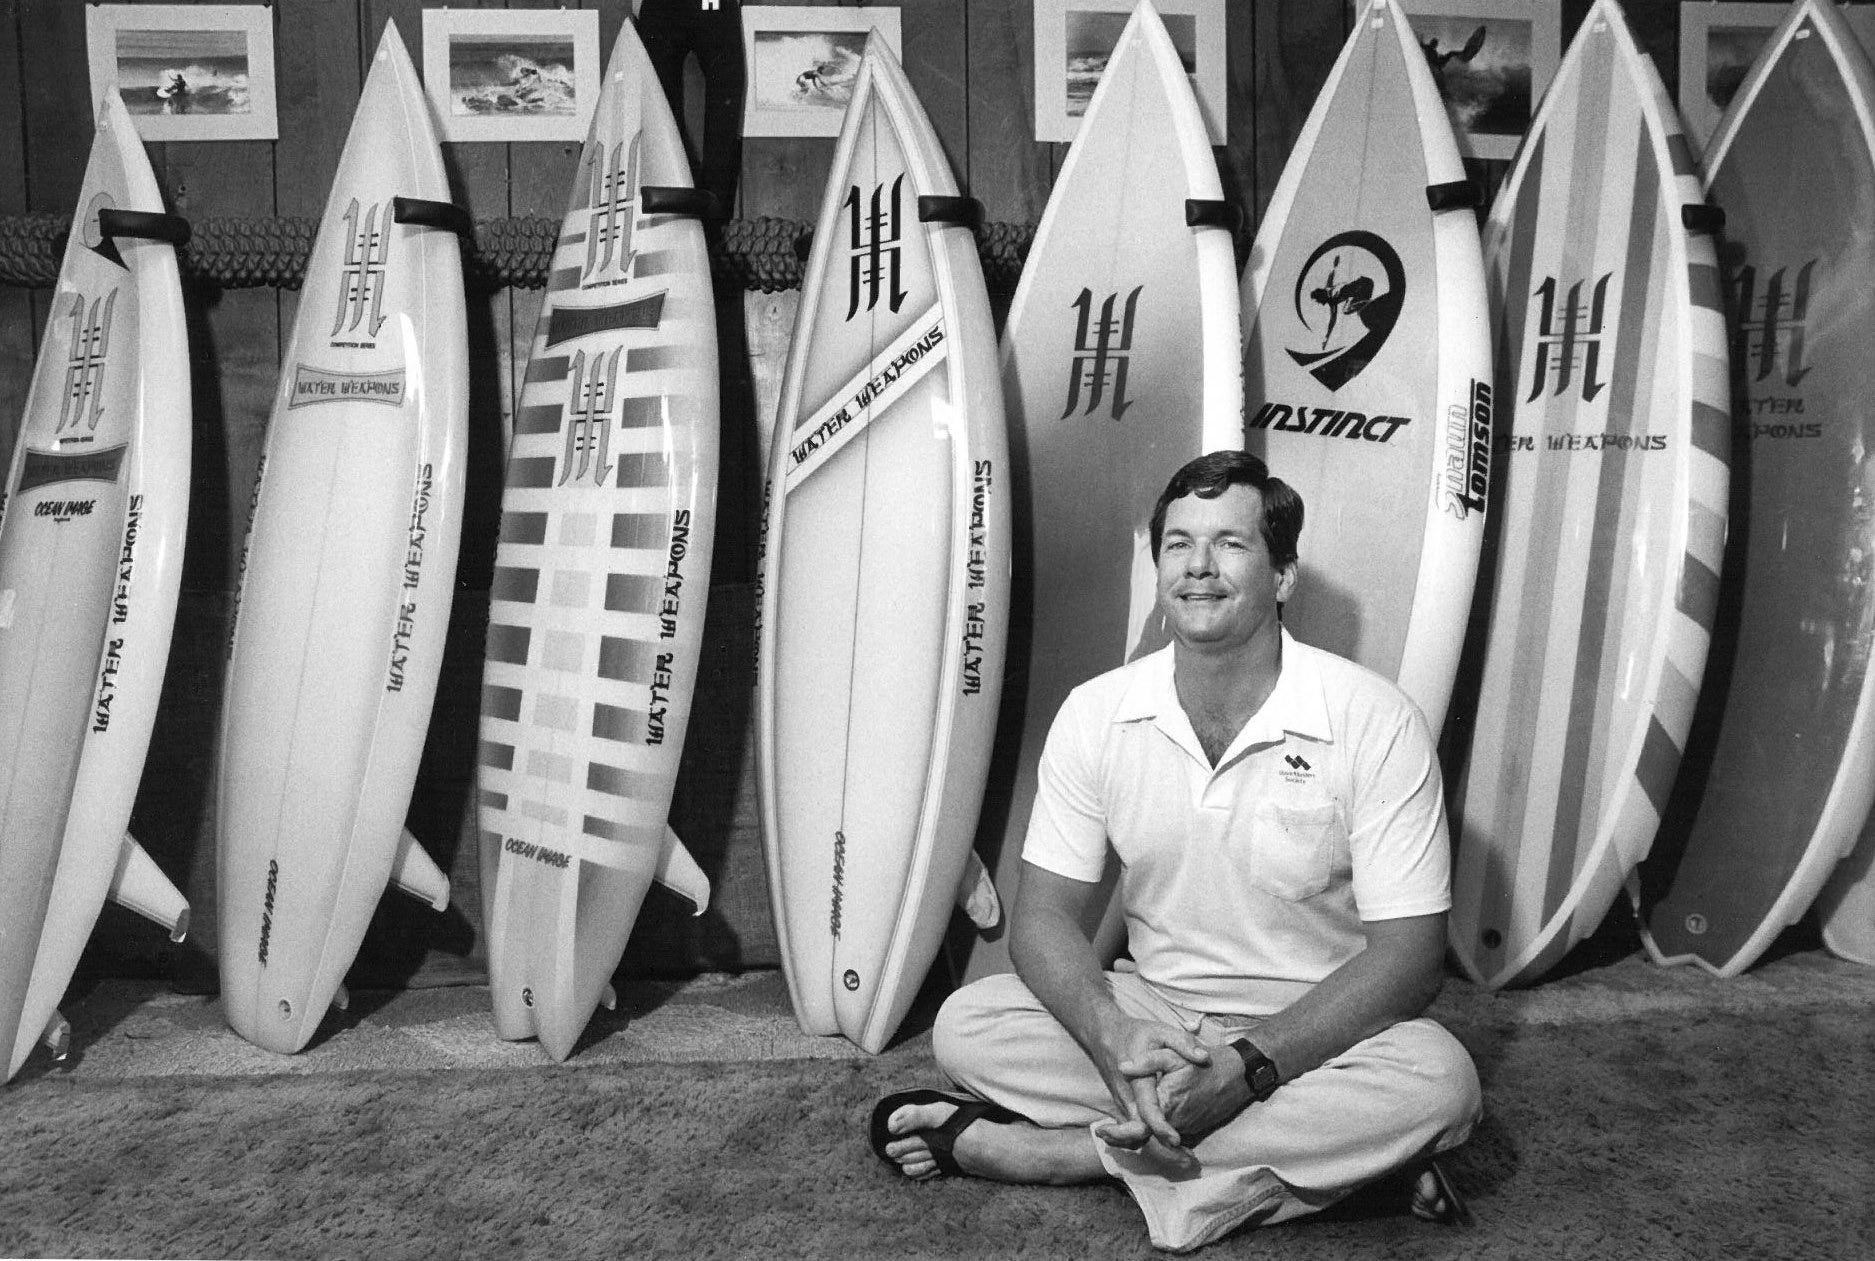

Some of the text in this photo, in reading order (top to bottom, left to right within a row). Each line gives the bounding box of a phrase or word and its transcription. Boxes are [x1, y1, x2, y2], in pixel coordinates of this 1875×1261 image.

[298, 379, 400, 395] WATER WEAPONS
[788, 326, 945, 464] WATER WEAPONS
[1751, 395, 1805, 415] TER
[1547, 435, 1667, 452] WEAPONS
[1752, 421, 1822, 440] PONS
[386, 463, 433, 693] WATER WEAPONS
[962, 459, 992, 697] WATER WEAPONS
[645, 509, 691, 746] WATER WEAPONS
[93, 638, 124, 734] WATER
[505, 837, 538, 859] OCEAN
